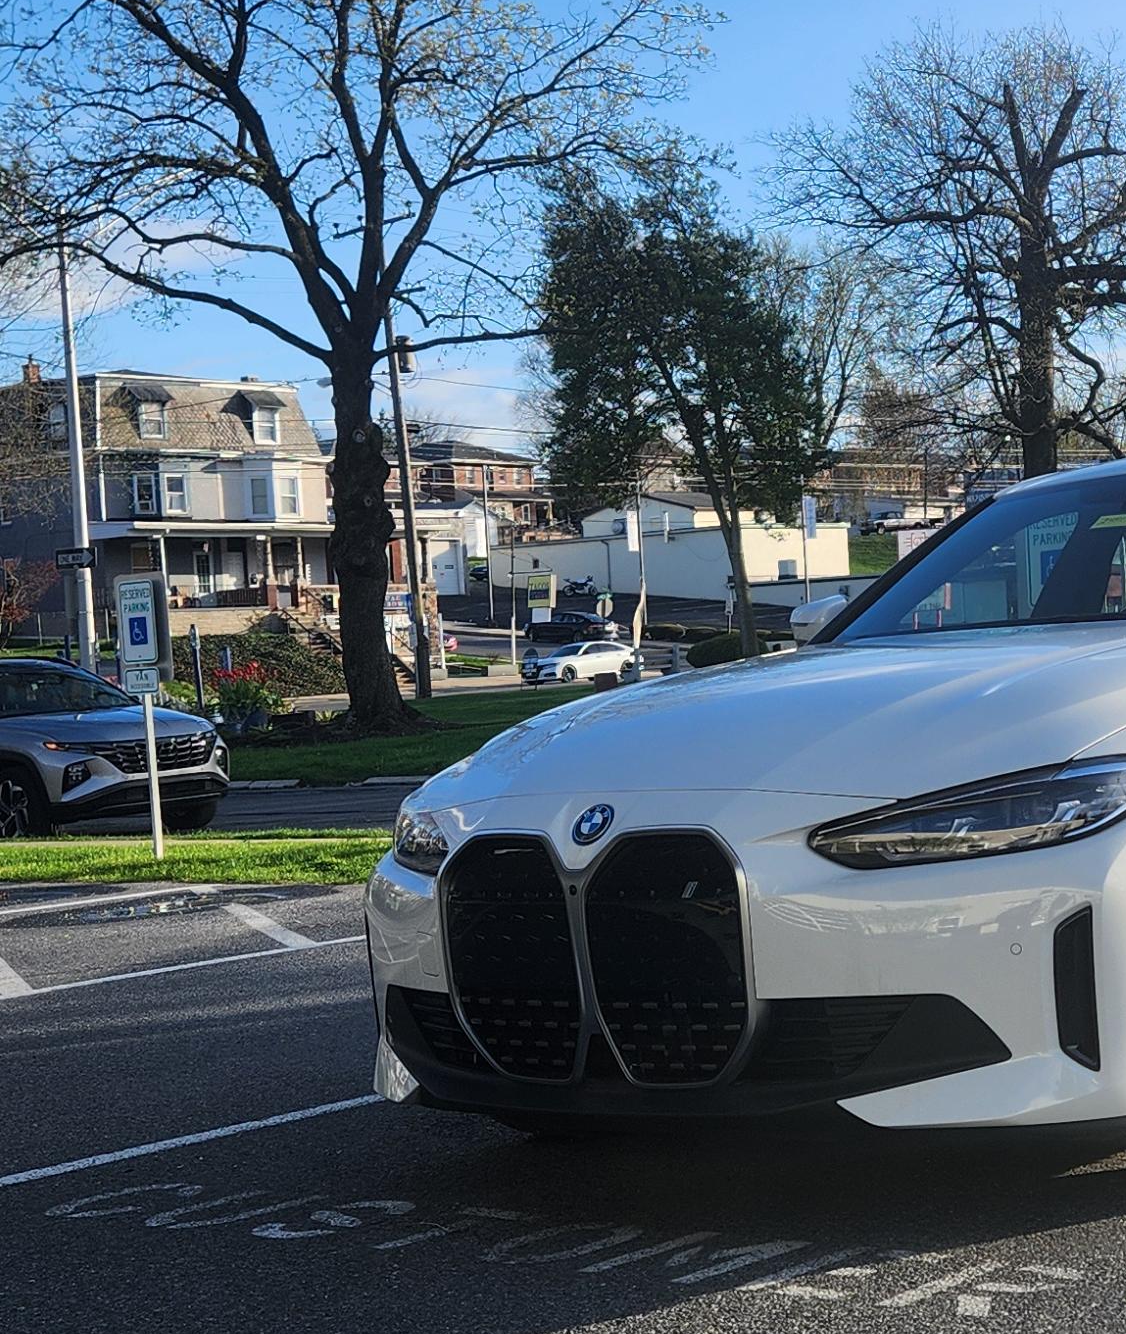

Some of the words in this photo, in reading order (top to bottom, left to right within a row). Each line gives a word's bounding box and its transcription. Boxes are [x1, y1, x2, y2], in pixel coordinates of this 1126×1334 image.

[59, 554, 70, 564] ONE
[71, 553, 83, 563] WAY
[121, 587, 150, 600] RESERVED
[123, 601, 150, 614] PARKING
[135, 672, 149, 682] VAN
